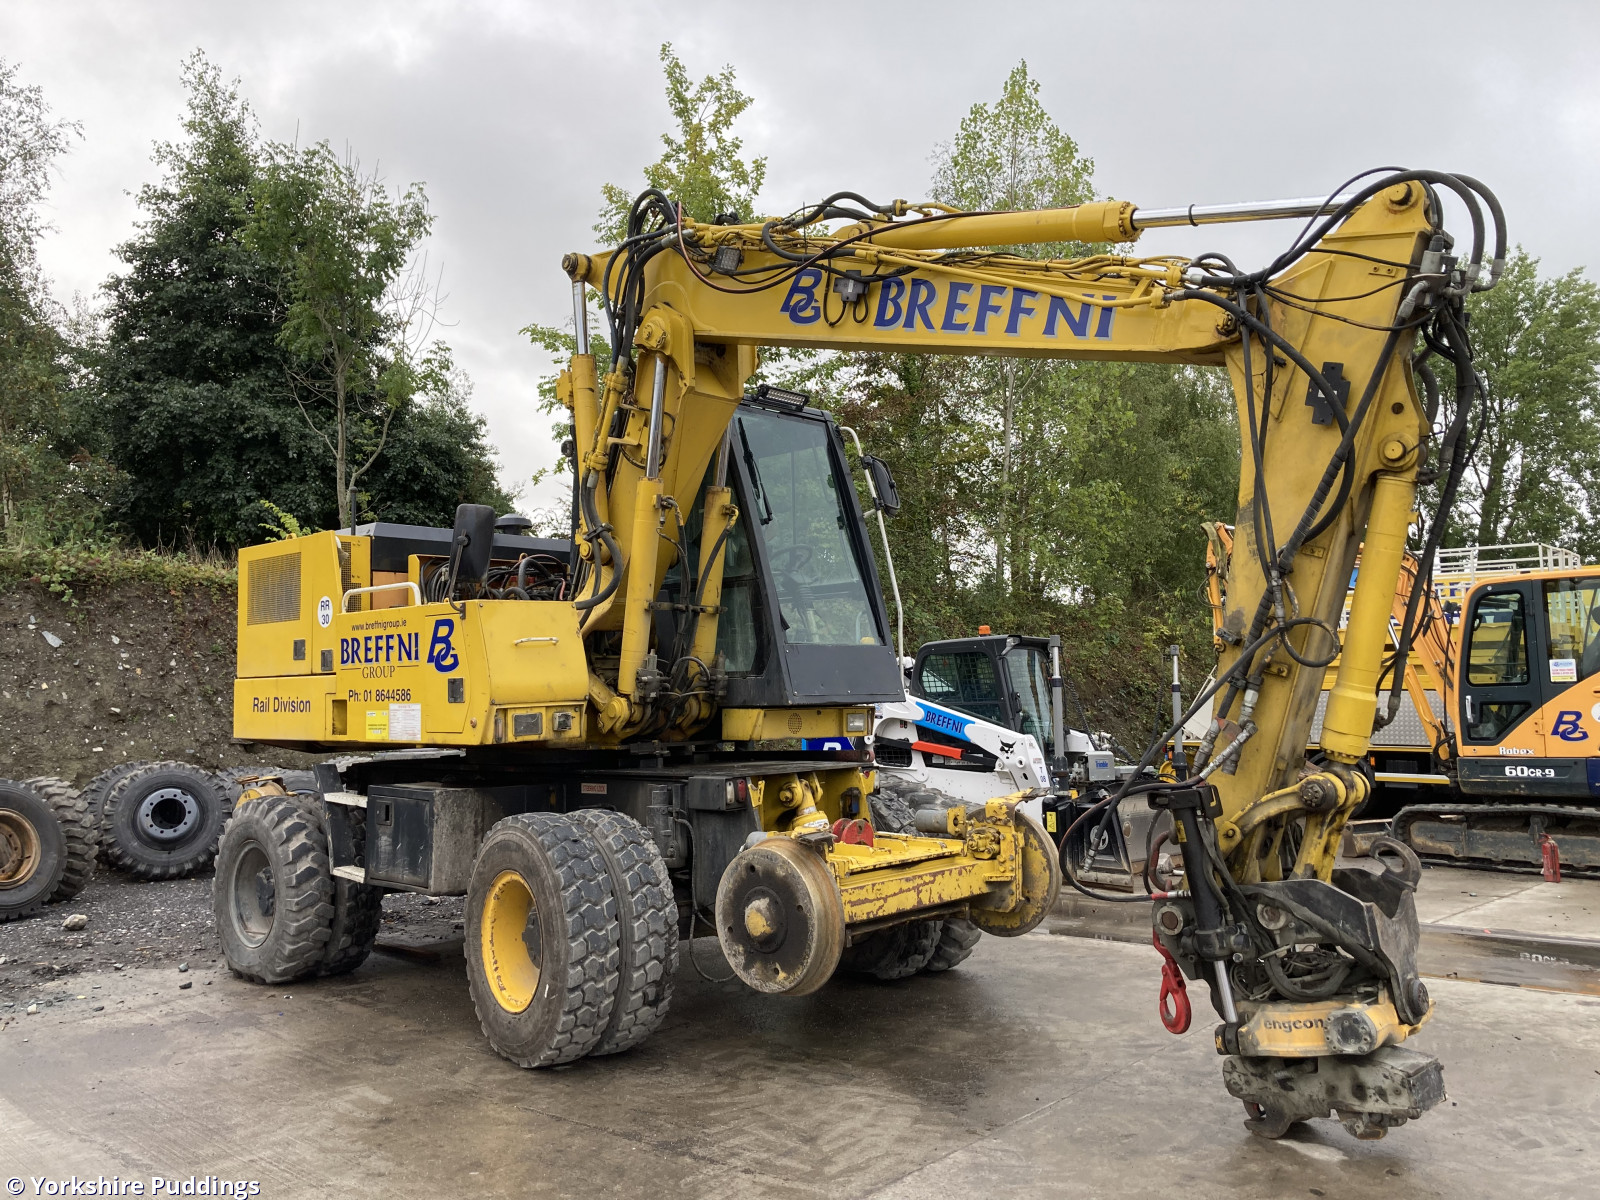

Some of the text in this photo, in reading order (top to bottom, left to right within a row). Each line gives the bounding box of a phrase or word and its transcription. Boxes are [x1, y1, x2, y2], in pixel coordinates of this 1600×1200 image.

[872, 276, 1117, 339] BREFFNI
[320, 599, 330, 611] RR
[321, 613, 330, 625] 30
[351, 619, 407, 631] www.breffnigroup.ie
[340, 632, 419, 665] BREFFNI
[361, 665, 396, 679] GROUP
[348, 688, 412, 702] Ph: 01 8644586
[252, 697, 311, 713] Rail Division
[925, 710, 963, 734] BREFFNI
[1504, 765, 1555, 778] 60CR-9
[1263, 1018, 1324, 1033] engcon
